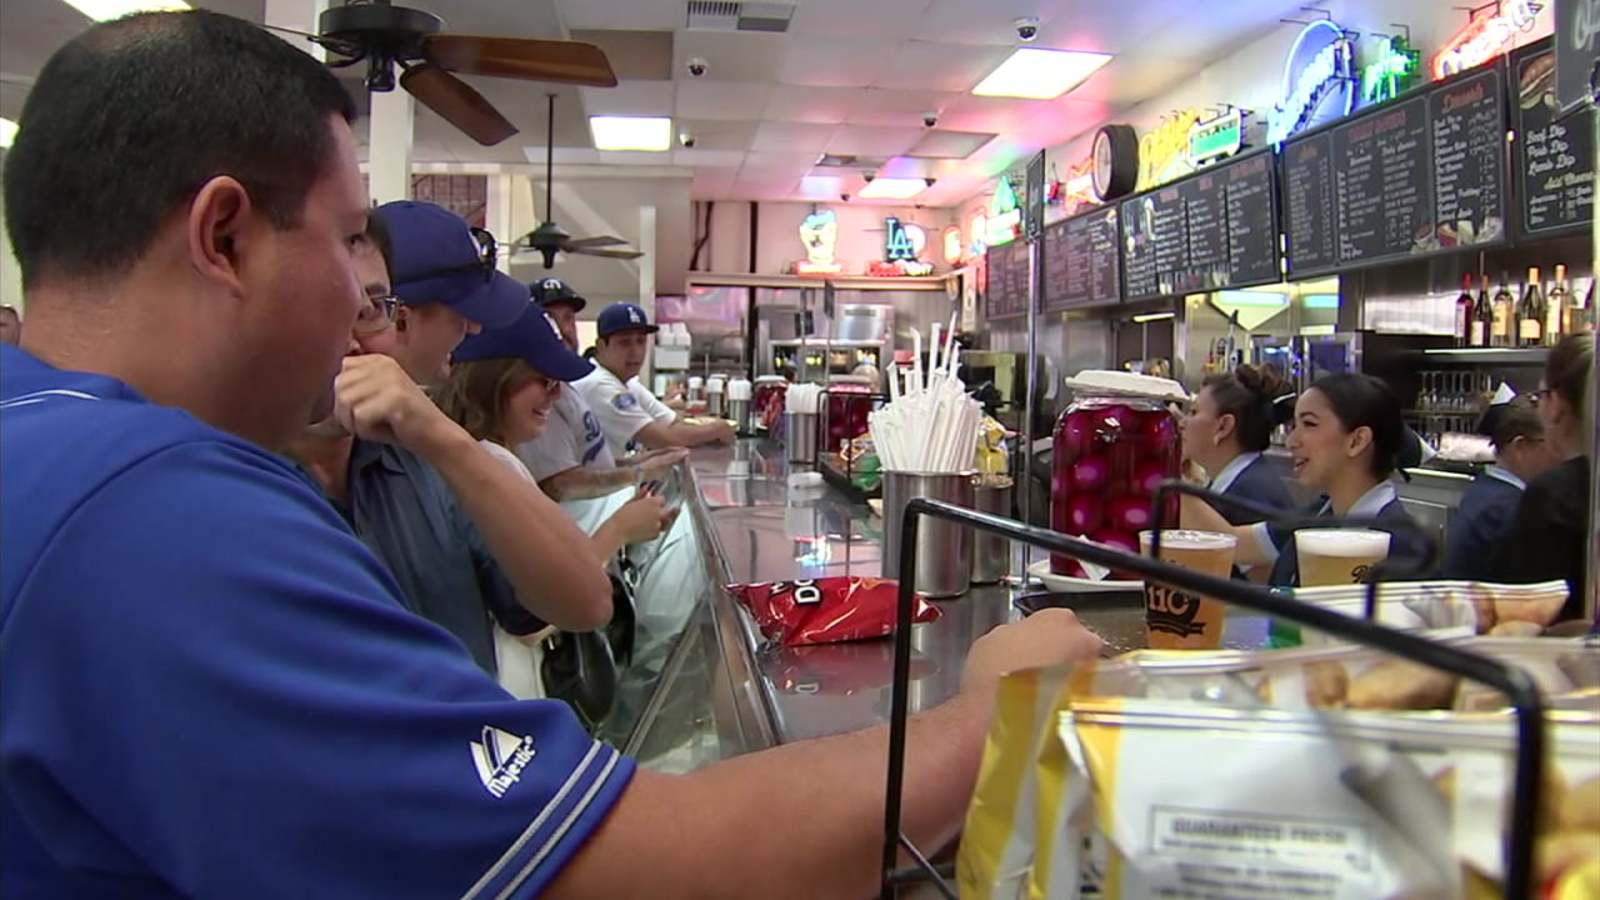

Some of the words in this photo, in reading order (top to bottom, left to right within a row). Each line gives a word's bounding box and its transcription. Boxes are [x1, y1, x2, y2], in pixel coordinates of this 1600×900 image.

[1549, 124, 1566, 138] Dip
[1550, 139, 1569, 154] Dip
[1555, 153, 1577, 169] Dip
[886, 218, 914, 259] LA
[627, 306, 641, 324] LA
